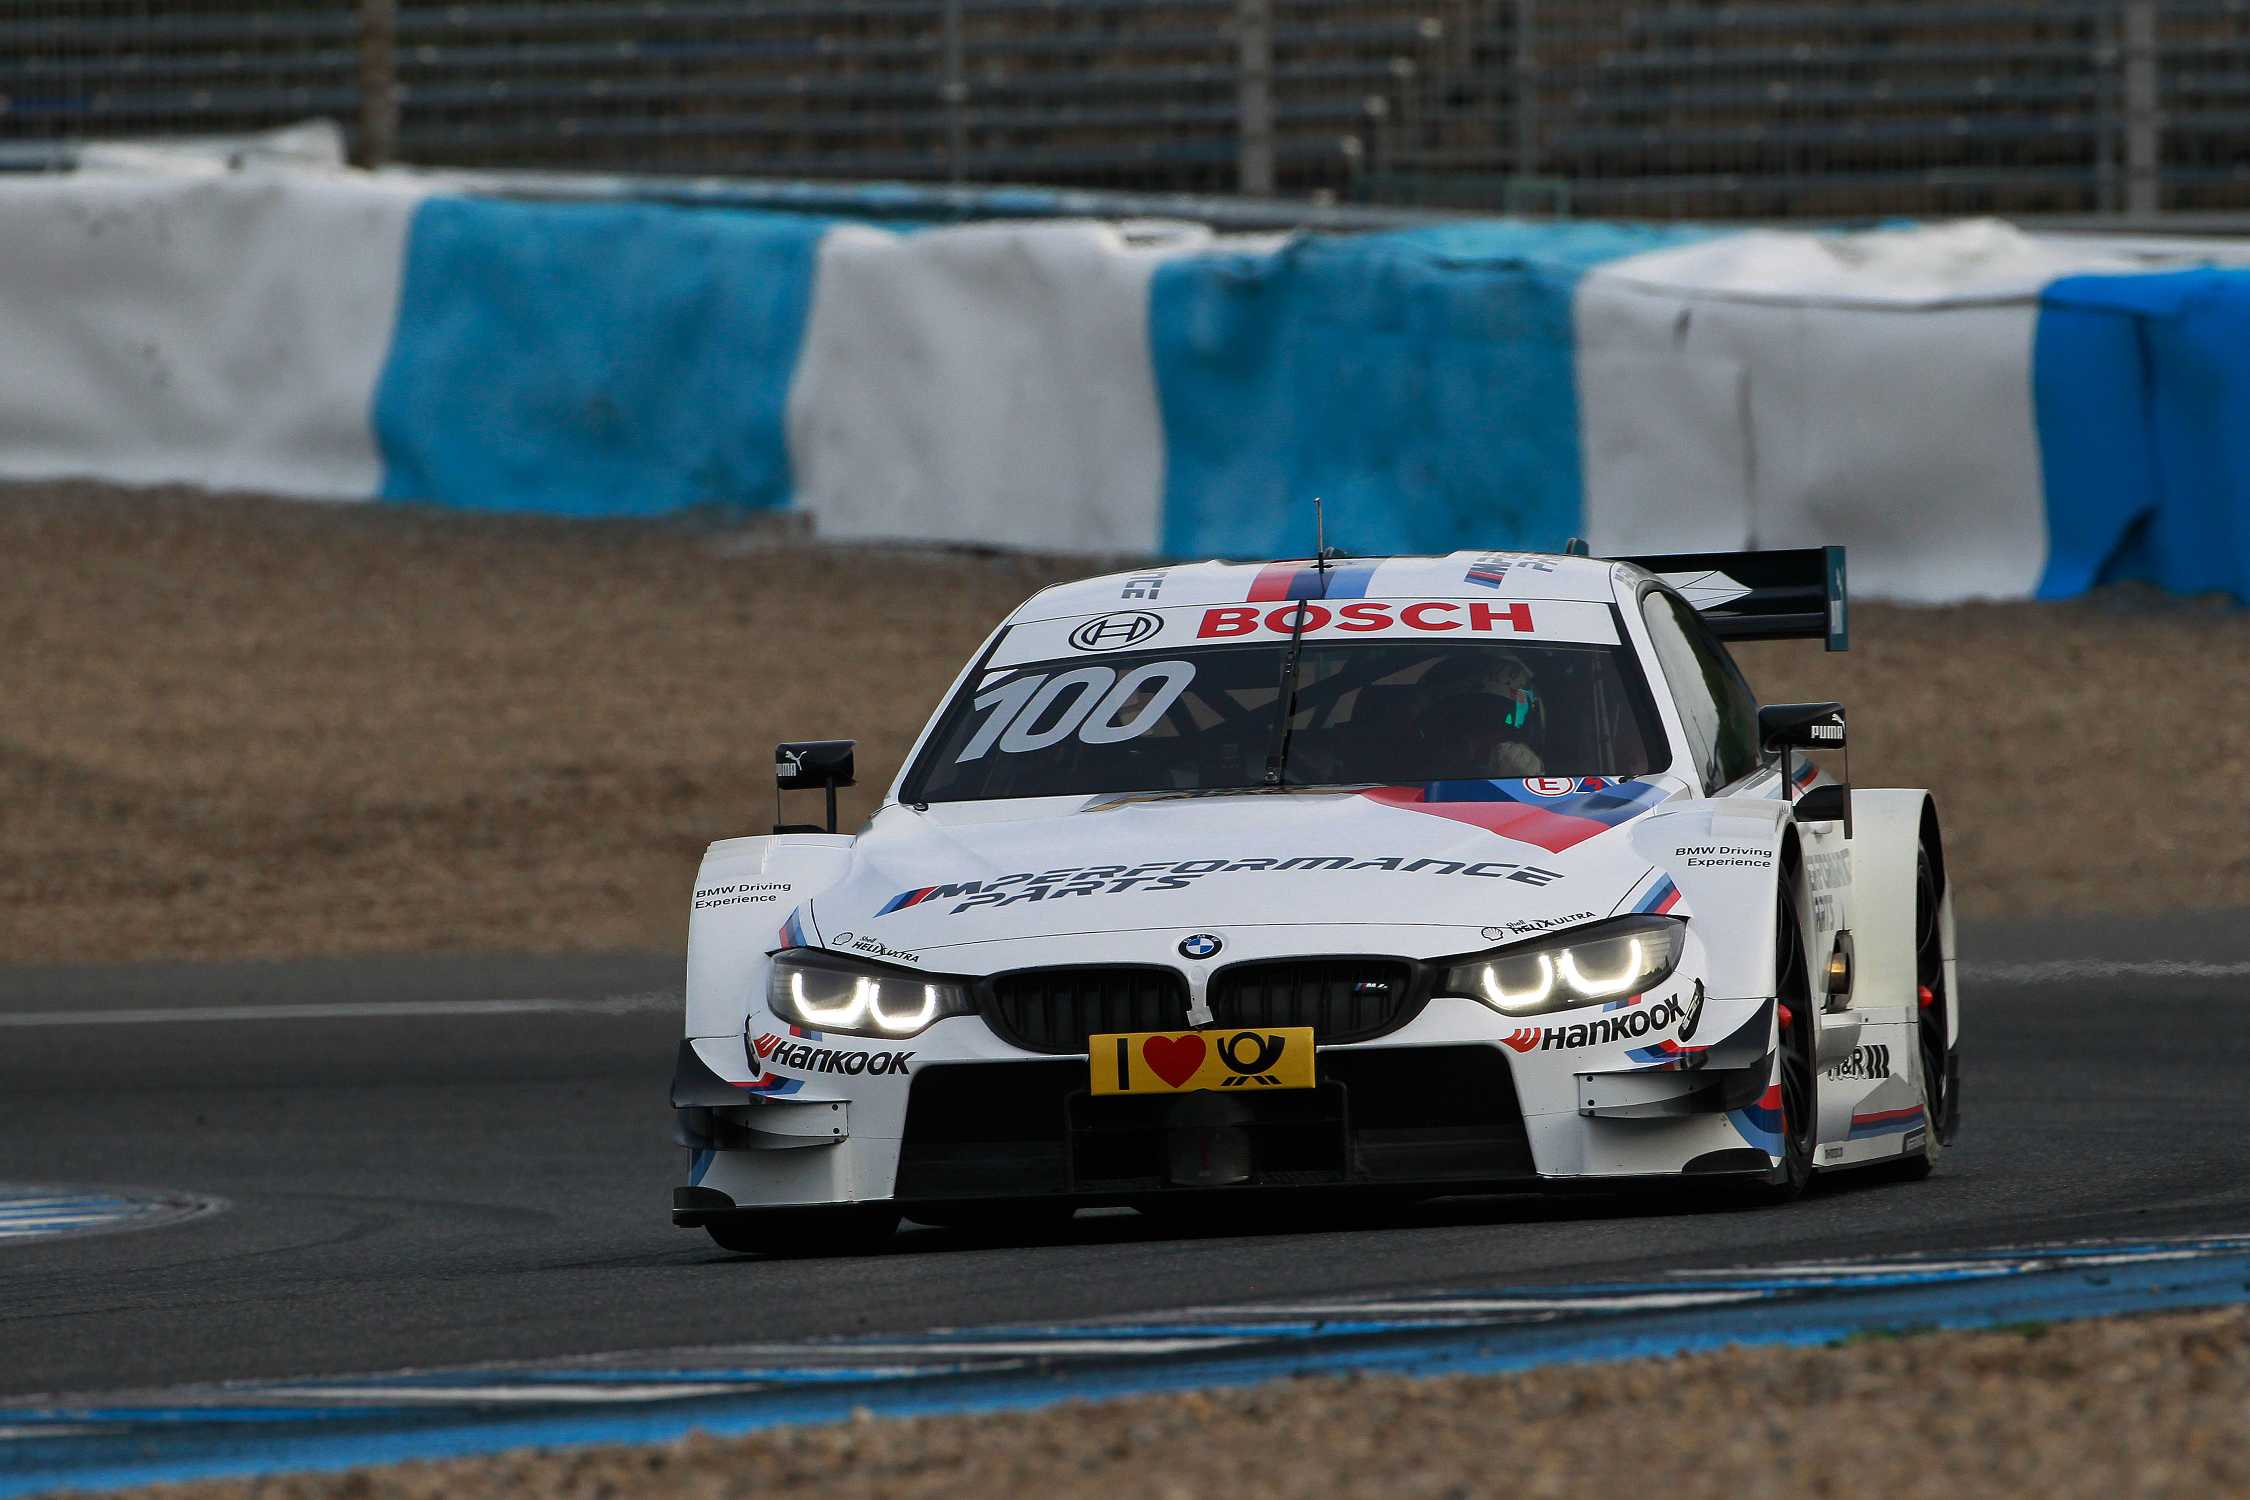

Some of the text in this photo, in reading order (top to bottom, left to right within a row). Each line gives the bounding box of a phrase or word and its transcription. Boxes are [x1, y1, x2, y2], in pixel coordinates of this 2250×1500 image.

[1196, 602, 1535, 638] BOSCH
[955, 660, 1196, 763] 100
[1811, 725, 1843, 739] PUMA
[1675, 846, 1773, 858] BMW Driving
[1687, 858, 1771, 867] Experience
[980, 856, 1565, 893] PERFORMANCE
[696, 883, 791, 898] BMW Driving
[949, 872, 1206, 916] PARTS
[695, 895, 777, 909] Experience
[1512, 911, 1596, 934] HELIX ULTRA
[852, 941, 920, 962] HELIX ULTRA
